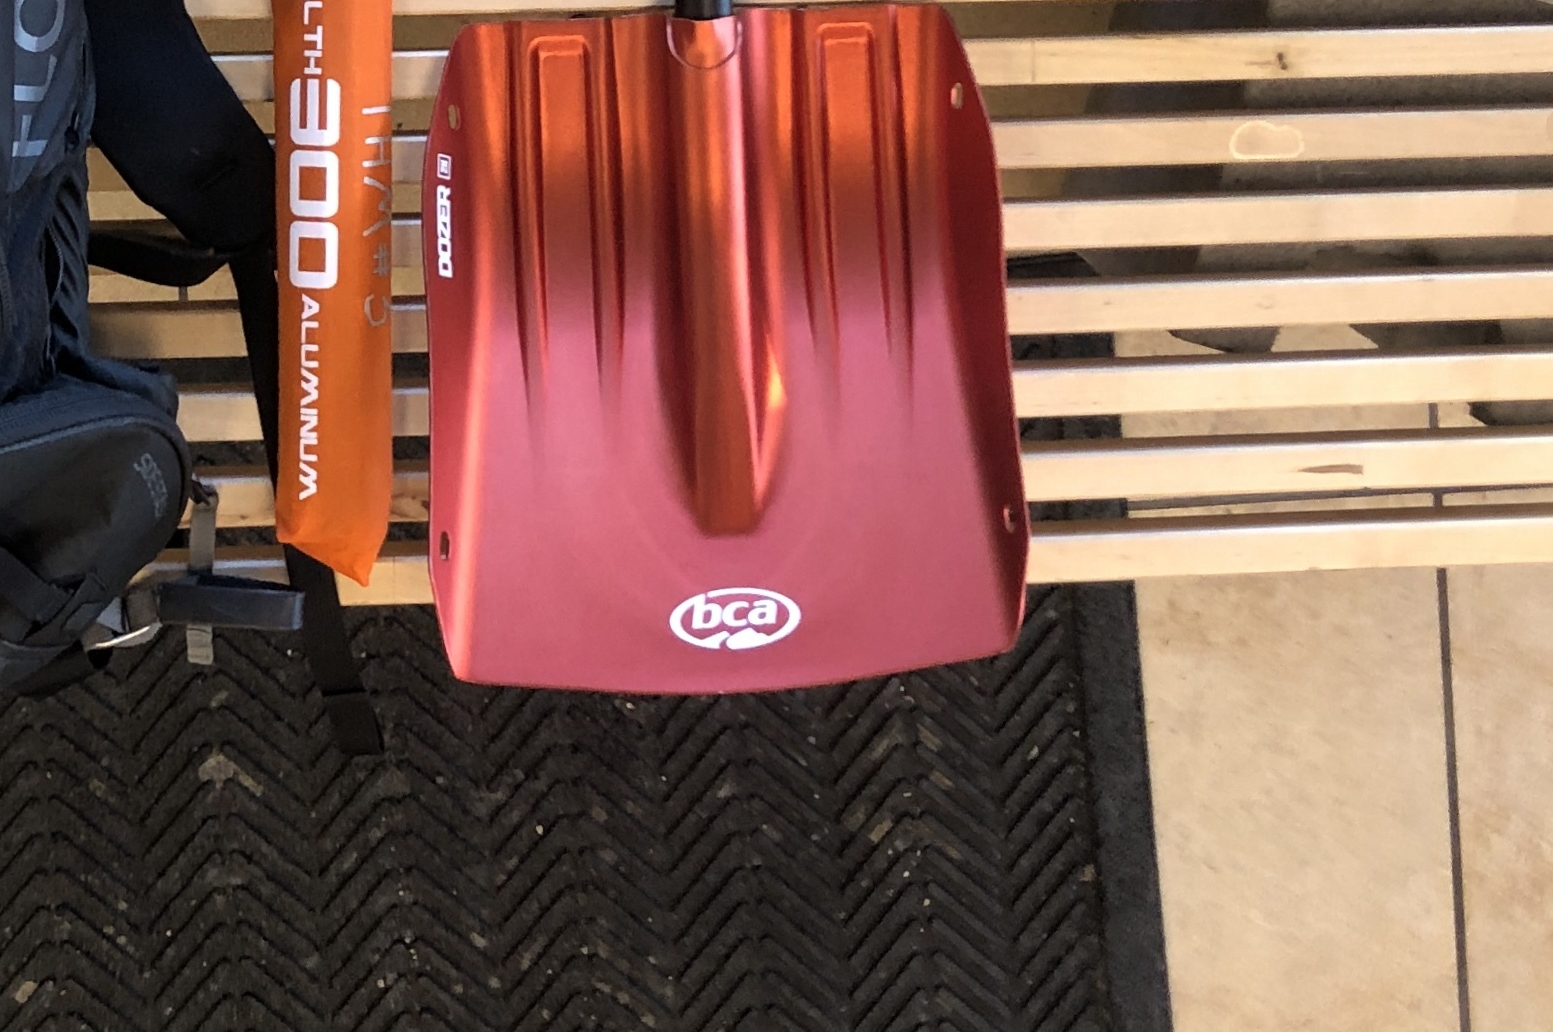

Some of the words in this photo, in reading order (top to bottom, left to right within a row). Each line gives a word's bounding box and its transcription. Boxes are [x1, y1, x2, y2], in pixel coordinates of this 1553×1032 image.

[289, 79, 341, 289] 300
[437, 185, 452, 278] DOZER
[298, 294, 320, 501] ALUMINUM
[692, 594, 778, 629] bca
